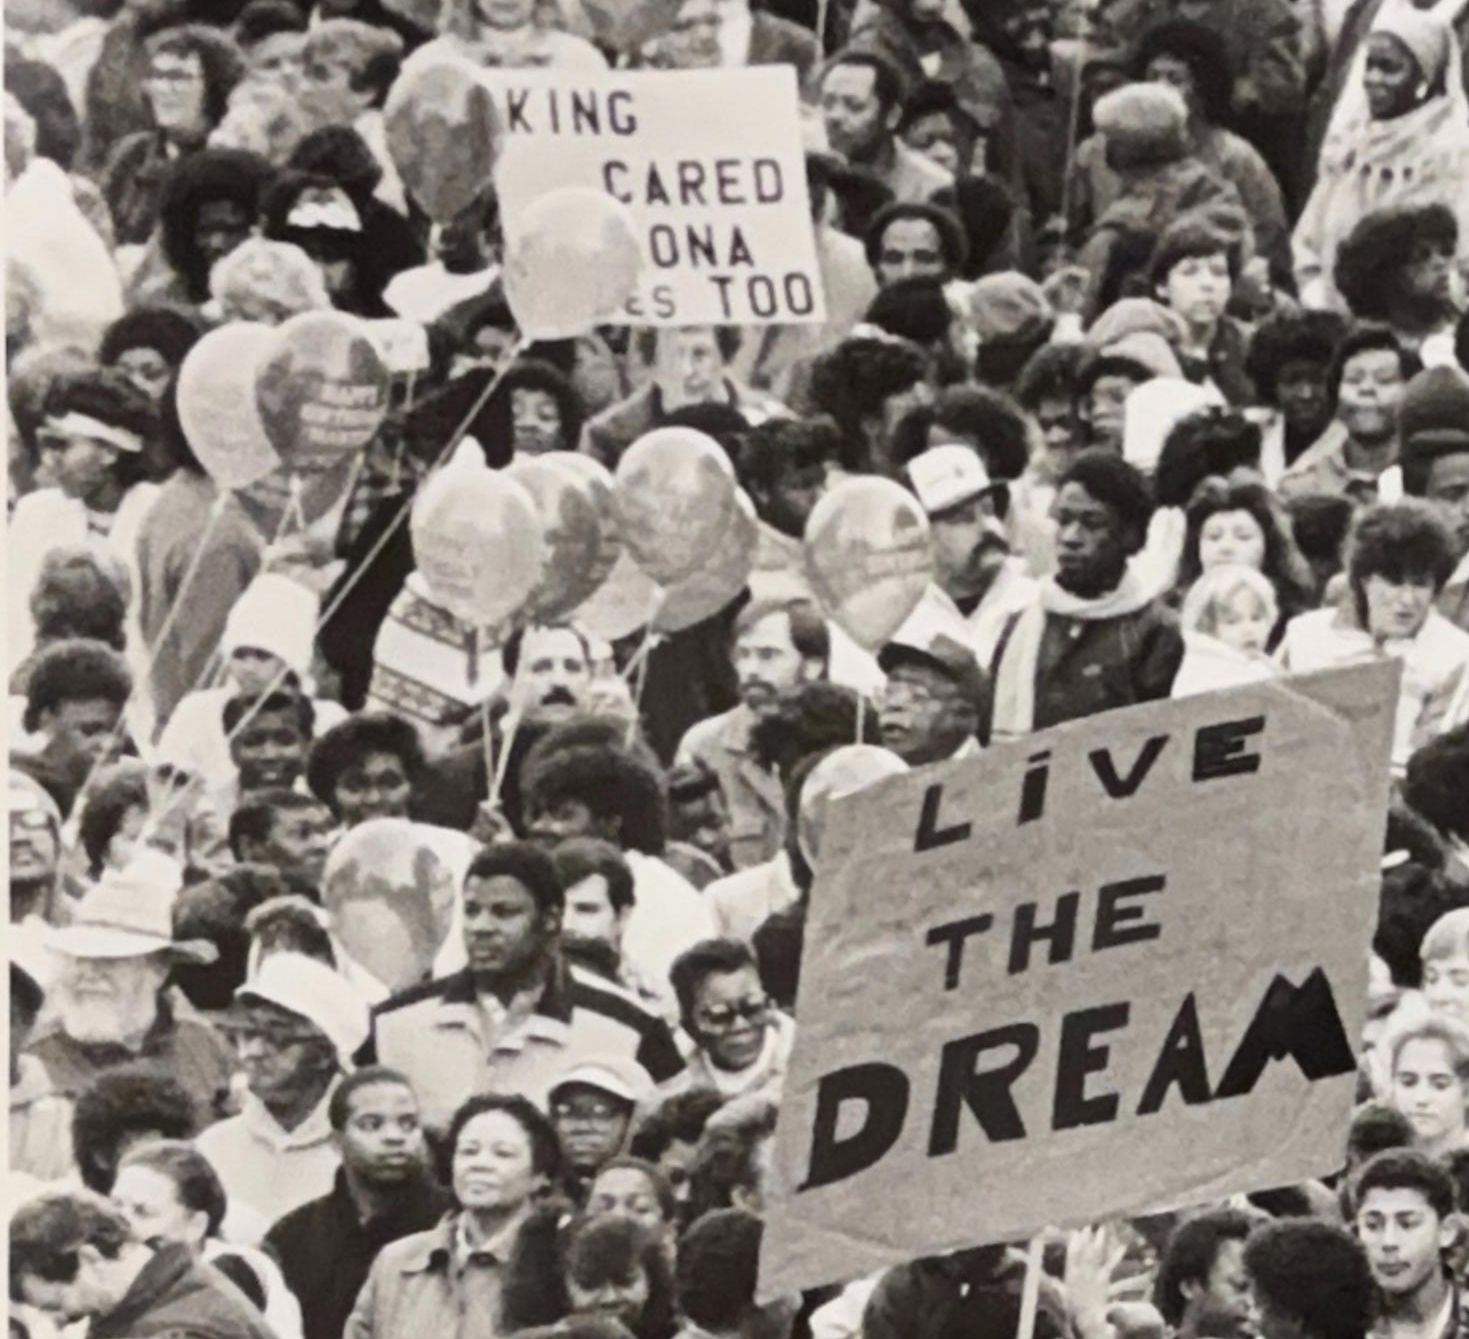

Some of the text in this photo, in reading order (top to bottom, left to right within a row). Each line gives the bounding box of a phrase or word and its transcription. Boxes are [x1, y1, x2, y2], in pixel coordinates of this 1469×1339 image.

[507, 88, 639, 137] KING
[602, 158, 784, 207] CARED
[709, 271, 815, 320] TOO
[925, 873, 1166, 991] THE
[796, 965, 1359, 1194] DREAM
